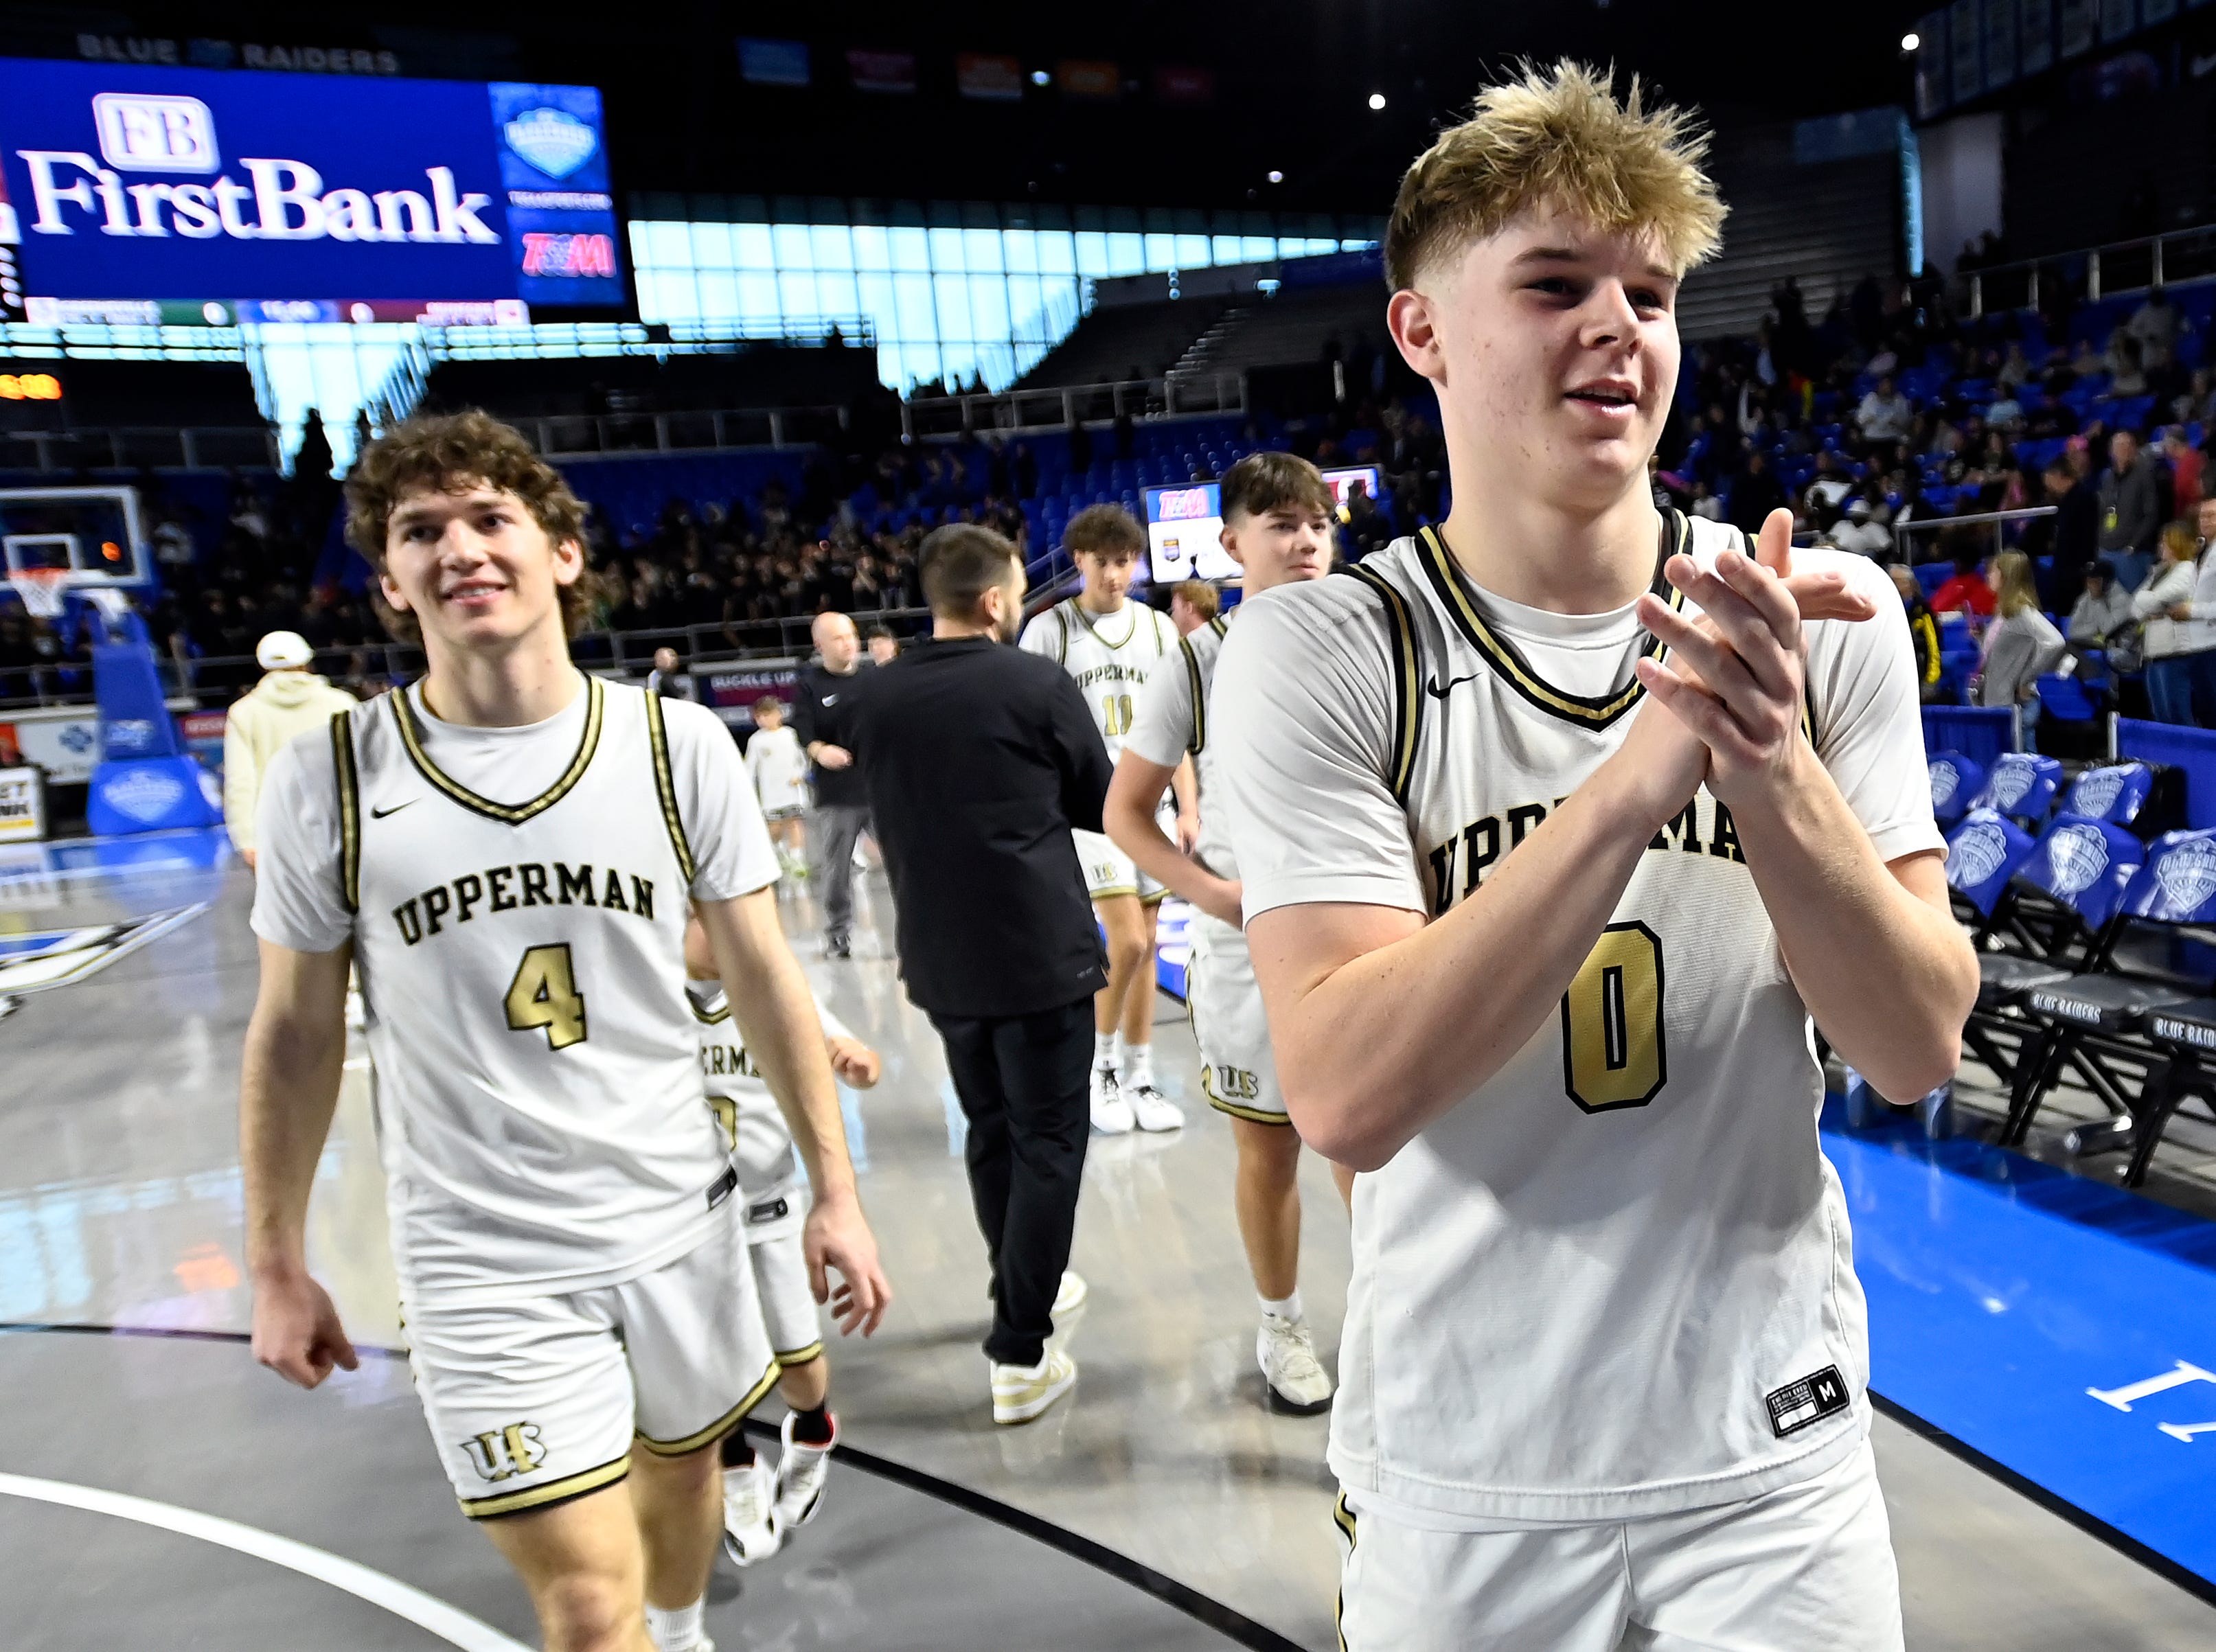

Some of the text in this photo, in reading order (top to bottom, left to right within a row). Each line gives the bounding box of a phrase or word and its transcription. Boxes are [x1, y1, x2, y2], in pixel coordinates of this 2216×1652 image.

[76, 33, 400, 73] BLUE RAIDERS
[110, 105, 202, 158] FB
[16, 150, 502, 244] FirstBank
[1073, 664, 1148, 690] UPPERMA
[392, 862, 654, 946] UPPERMAN
[503, 942, 587, 1051] 4
[1560, 920, 1667, 1115] 0
[2033, 993, 2102, 1024] BLUE RAIDERS
[2156, 1017, 2216, 1048] BLUE RAID
[1818, 1380, 1836, 1402] M
